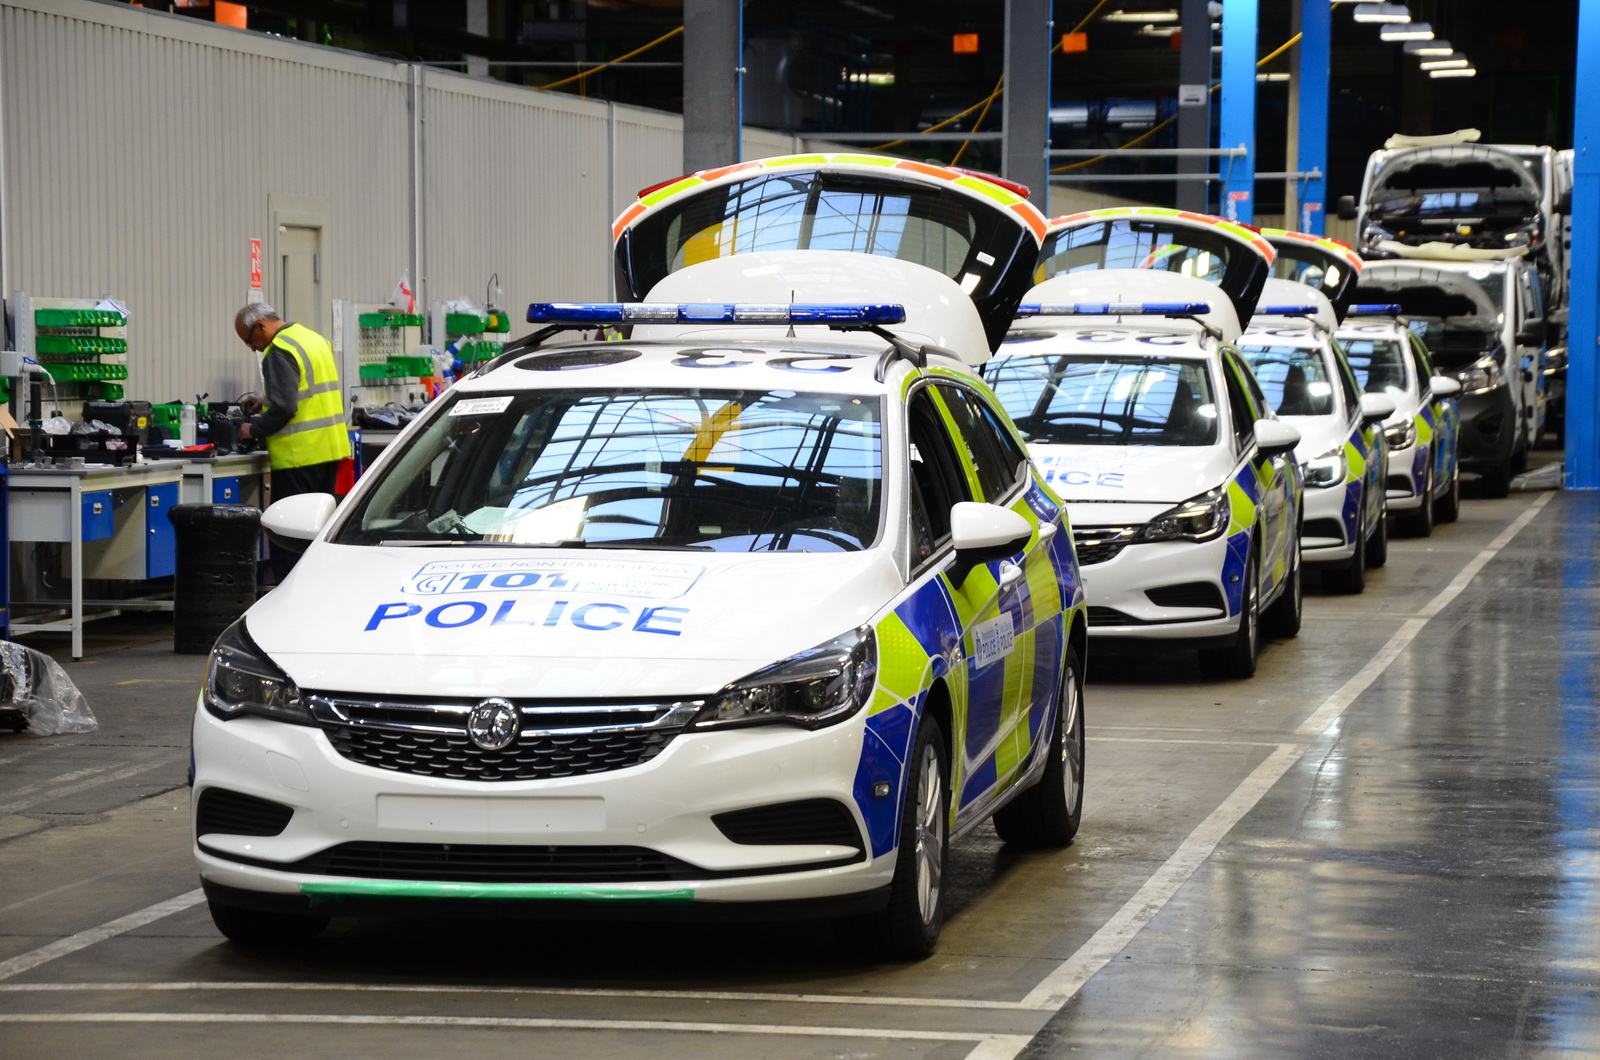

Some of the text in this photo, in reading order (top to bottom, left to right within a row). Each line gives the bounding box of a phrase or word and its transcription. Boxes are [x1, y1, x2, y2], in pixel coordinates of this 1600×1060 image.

[1044, 469, 1125, 488] ICE
[430, 562, 502, 571] POLICE
[459, 572, 570, 590] 101
[364, 600, 691, 637] POLICE
